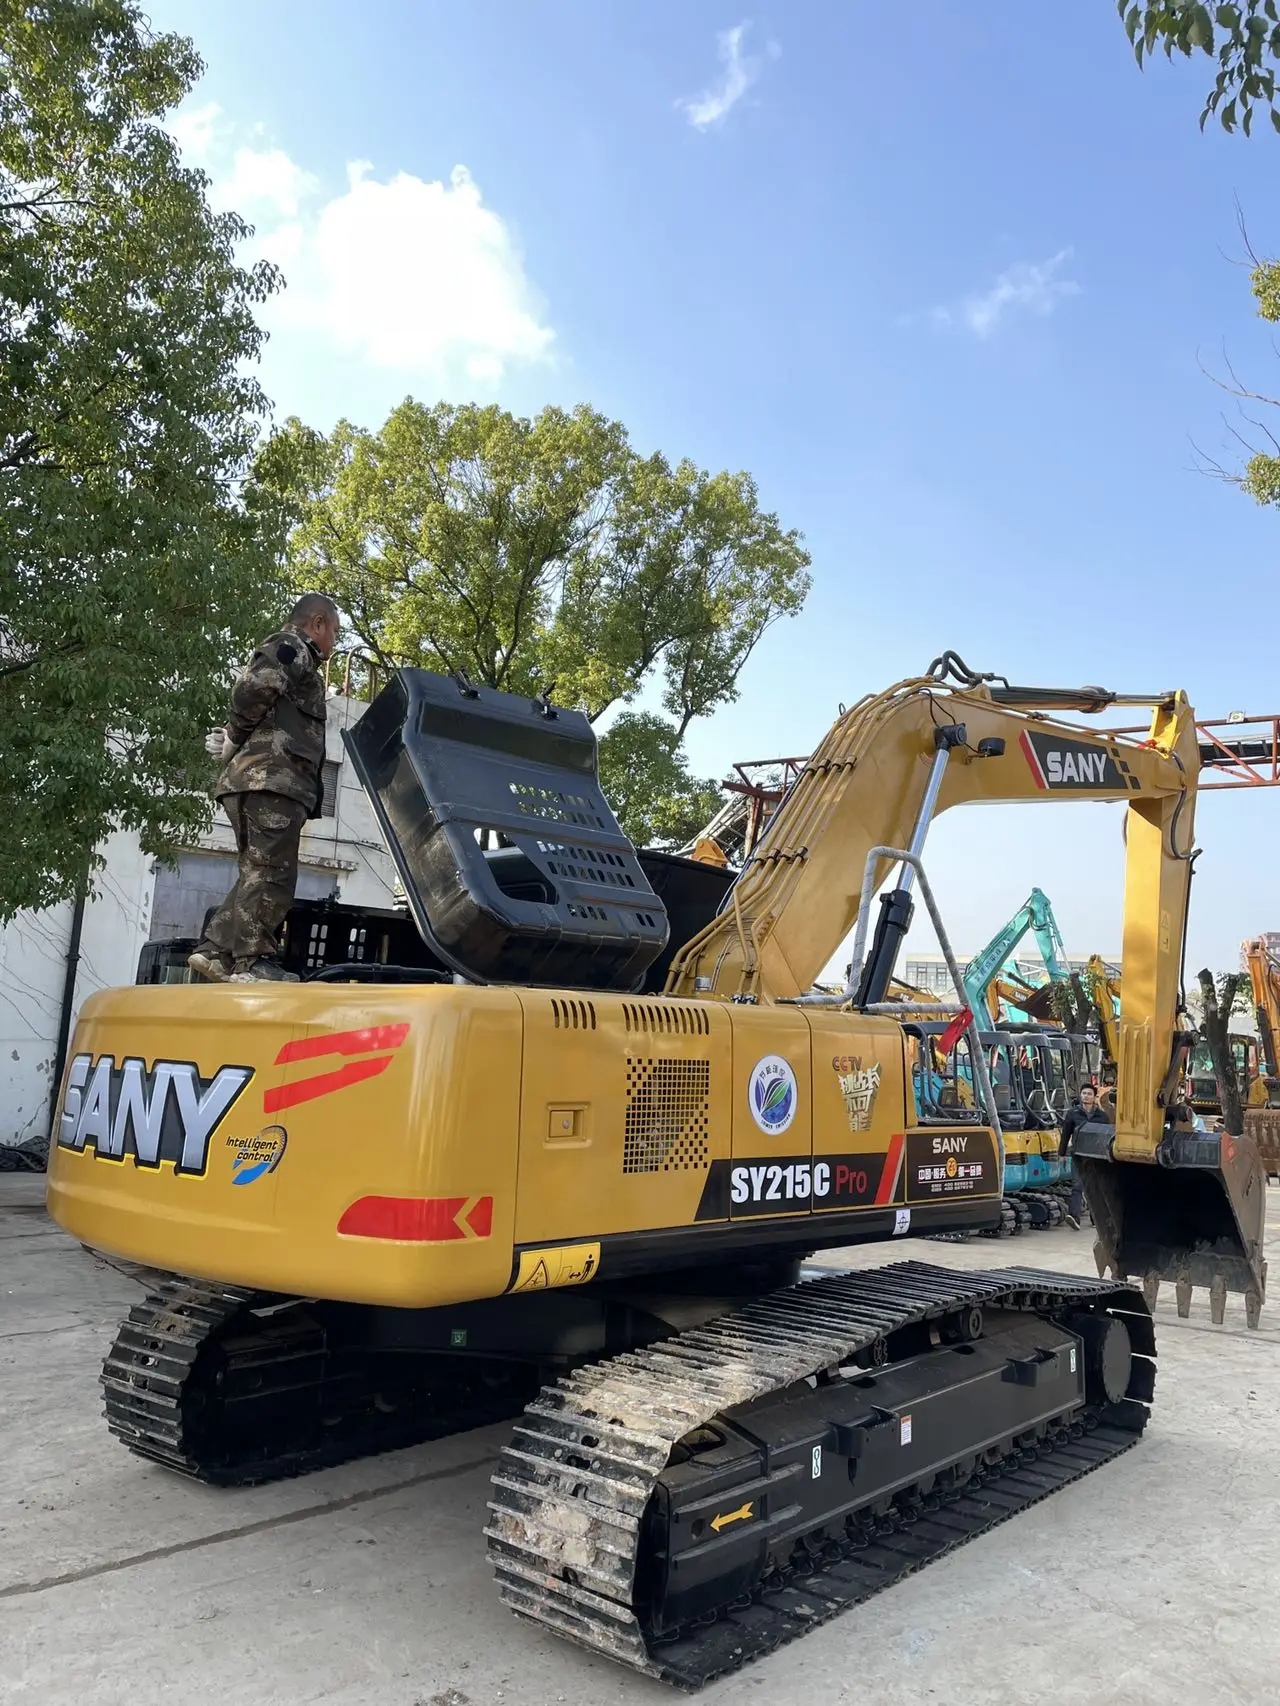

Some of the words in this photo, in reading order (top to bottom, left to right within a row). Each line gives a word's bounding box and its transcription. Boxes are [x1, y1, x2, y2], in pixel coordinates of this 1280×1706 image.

[1046, 751, 1107, 783] SANY
[832, 1056, 863, 1072] CCTV
[59, 1053, 255, 1175] SANY
[225, 1135, 278, 1152] Intelligent
[932, 1137, 968, 1154] SANY
[236, 1151, 275, 1162] control
[731, 1162, 831, 1204] SY215C
[835, 1164, 868, 1195] Pro
